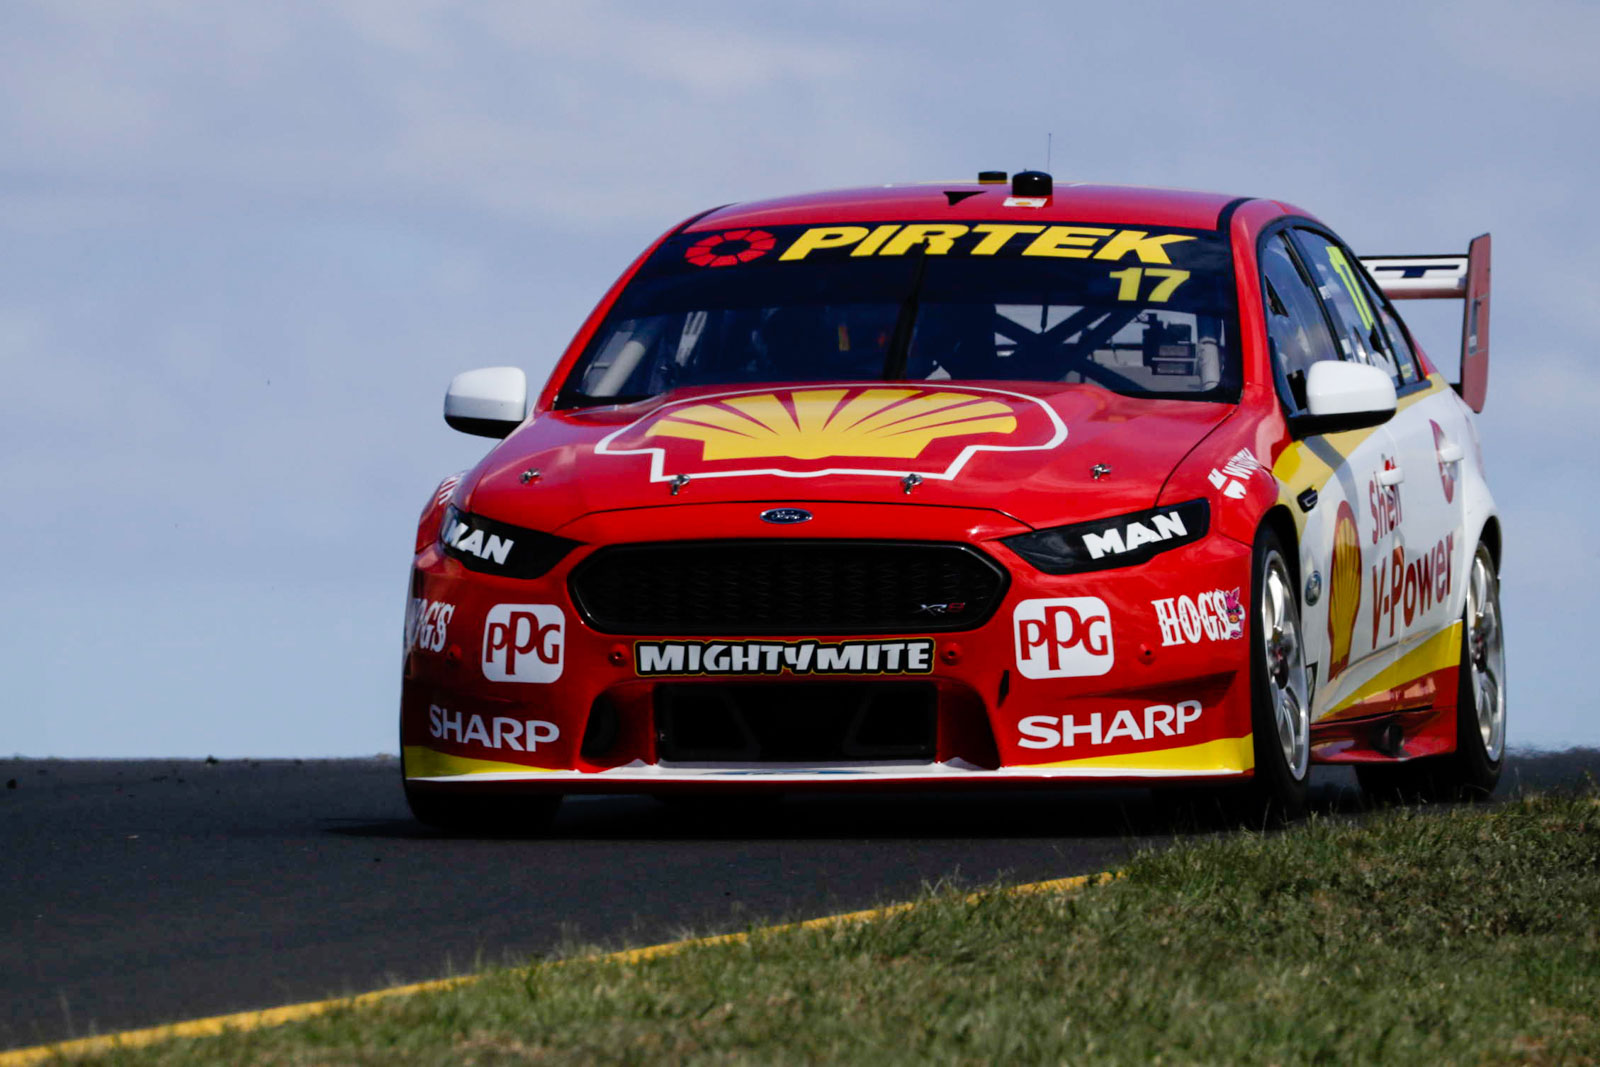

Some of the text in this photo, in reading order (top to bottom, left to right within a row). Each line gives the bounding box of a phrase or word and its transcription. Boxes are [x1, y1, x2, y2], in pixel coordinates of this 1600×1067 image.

[778, 223, 1198, 265] PIRTEK
[1109, 268, 1190, 303] 17
[1081, 511, 1188, 559] MAN
[1372, 531, 1454, 650] V-Power
[484, 611, 561, 675] PPG
[1019, 605, 1109, 671] PPG
[429, 703, 560, 752] SHARP
[1017, 699, 1203, 750] SHARP
